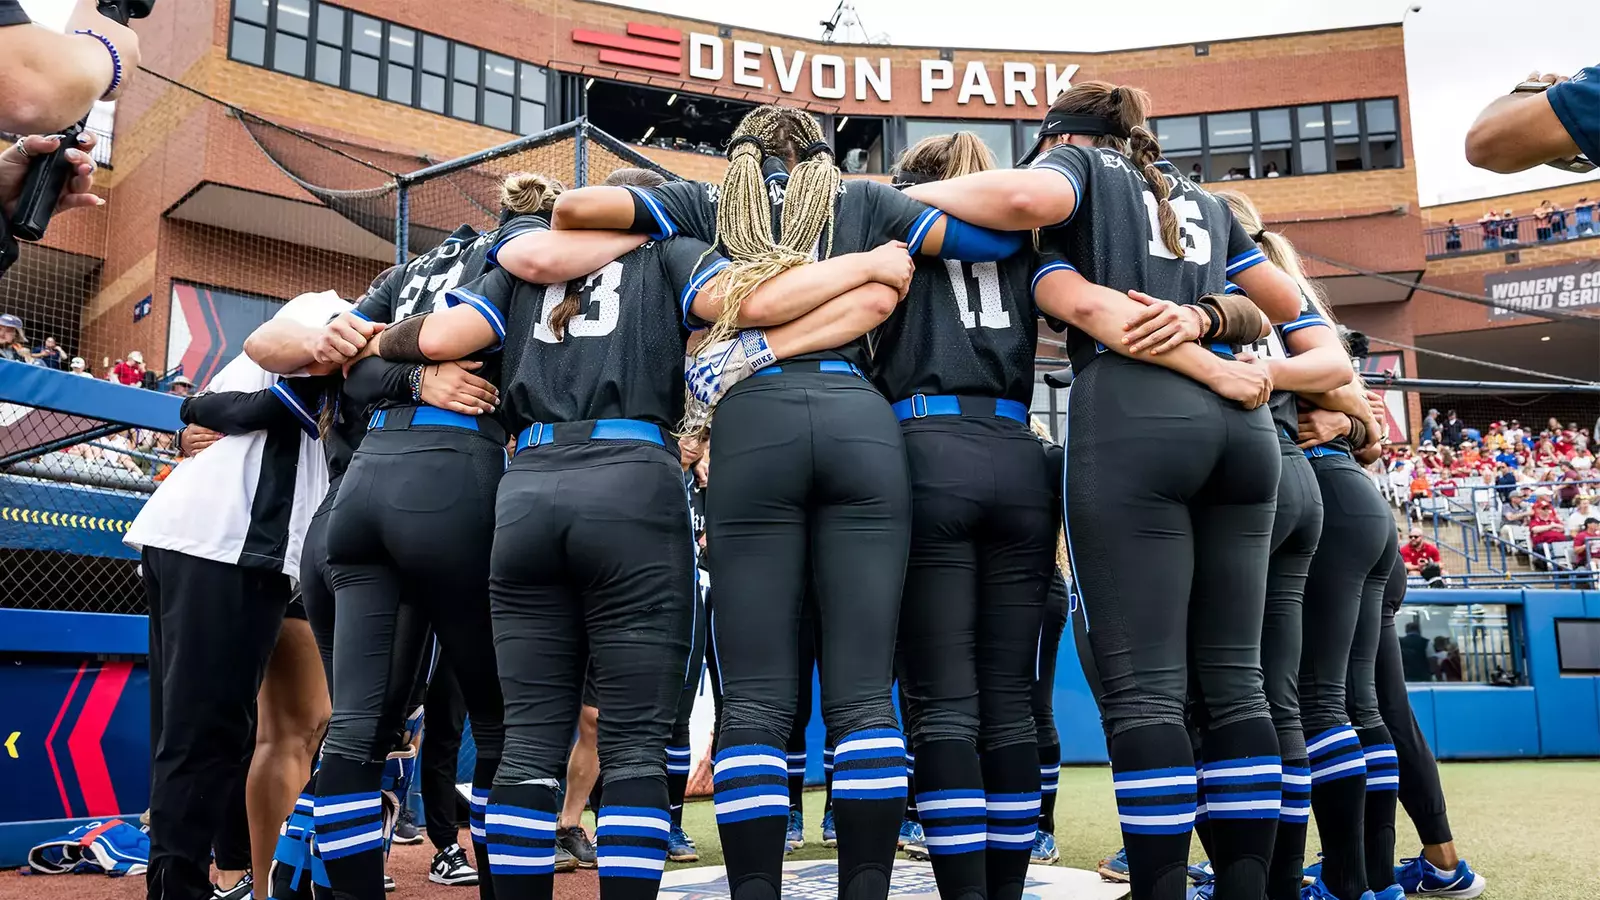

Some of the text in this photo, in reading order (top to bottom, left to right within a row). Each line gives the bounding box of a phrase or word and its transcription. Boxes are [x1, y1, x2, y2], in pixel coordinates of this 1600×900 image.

[689, 31, 1081, 106] DEVON PARK
[1142, 189, 1212, 266] 15
[533, 260, 624, 344] 13
[943, 258, 1011, 329] 11
[1492, 275, 1576, 300] WOMEN'S
[1558, 287, 1600, 308] SERI
[751, 353, 774, 369] DUKE
